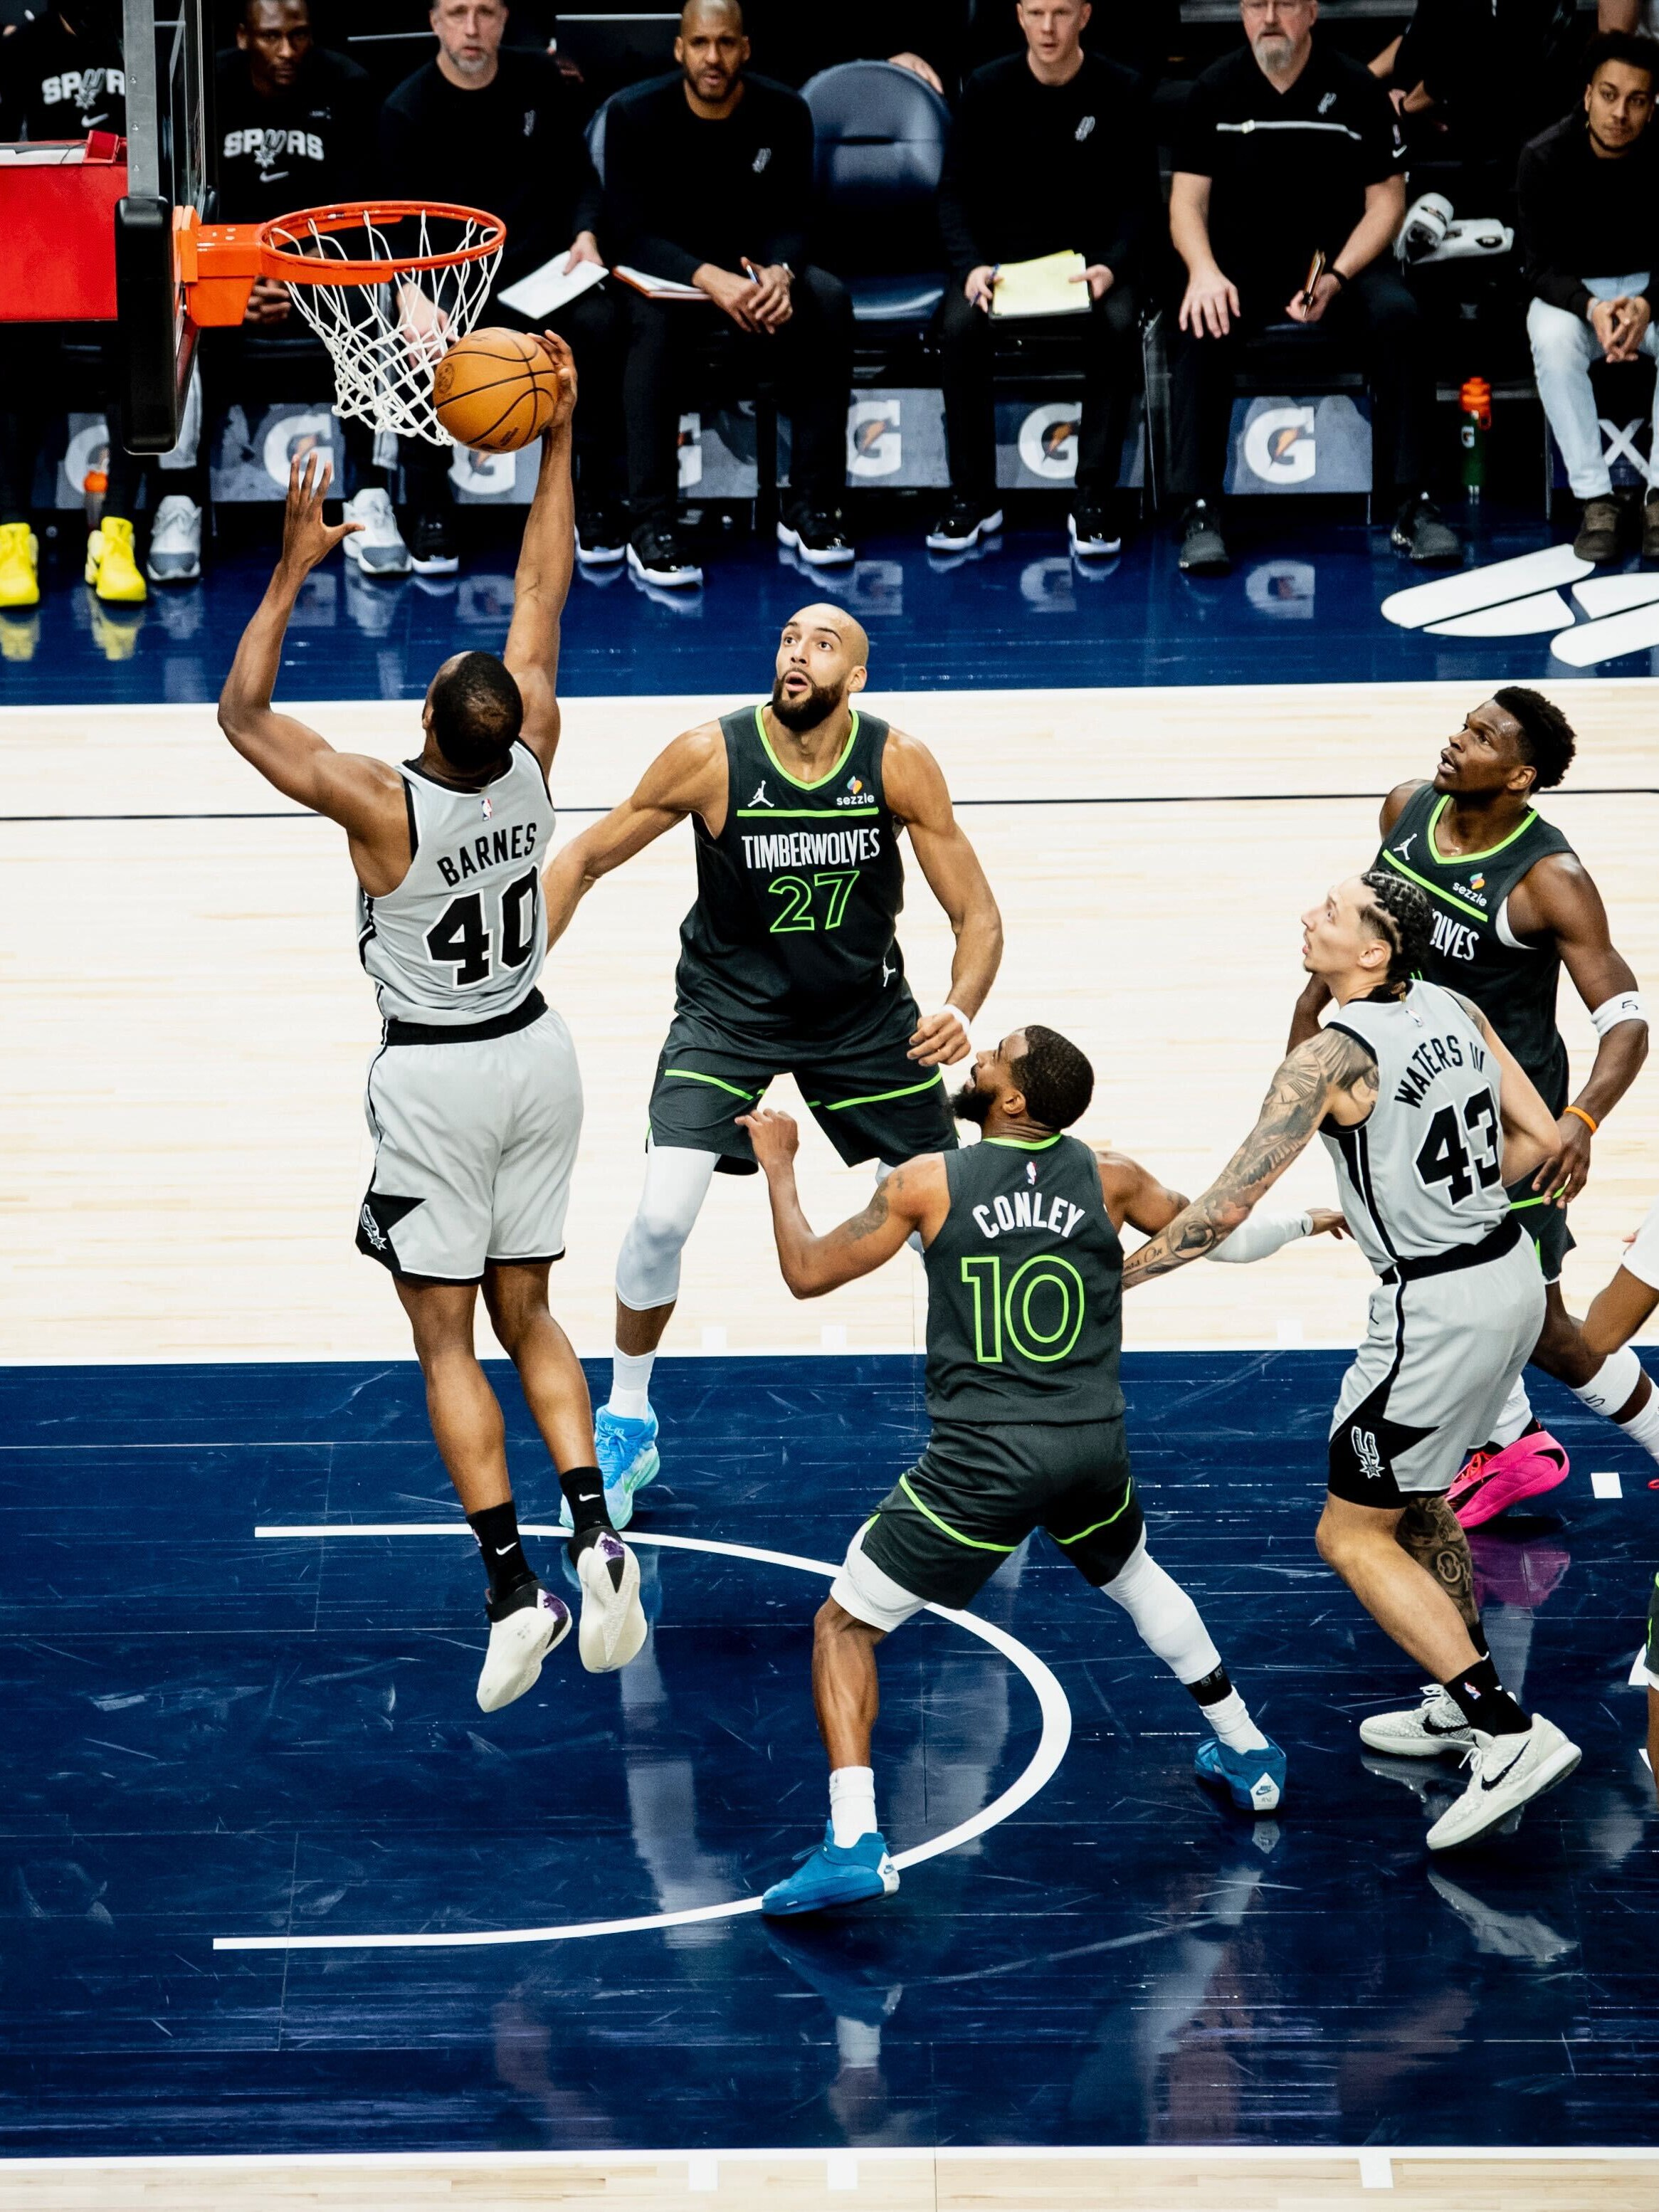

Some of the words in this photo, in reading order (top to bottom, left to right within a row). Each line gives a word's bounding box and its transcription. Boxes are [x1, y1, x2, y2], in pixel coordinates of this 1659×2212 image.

[41, 68, 125, 110] SPUR
[223, 128, 325, 169] SPURS
[846, 399, 902, 477] G
[1018, 401, 1082, 479] G
[1244, 405, 1316, 484] G
[836, 793, 875, 806] sezzle
[437, 823, 537, 887] BARNES
[741, 828, 880, 873] TIMBERWOLVES
[421, 862, 539, 990] 40
[768, 870, 860, 933] 27
[1453, 882, 1487, 907] sezzle
[1394, 1035, 1463, 1109] WATERS
[1470, 1041, 1485, 1073] III
[1412, 1081, 1502, 1211] 43
[972, 1191, 1085, 1238] CONLEY
[962, 1255, 1085, 1362] 10
